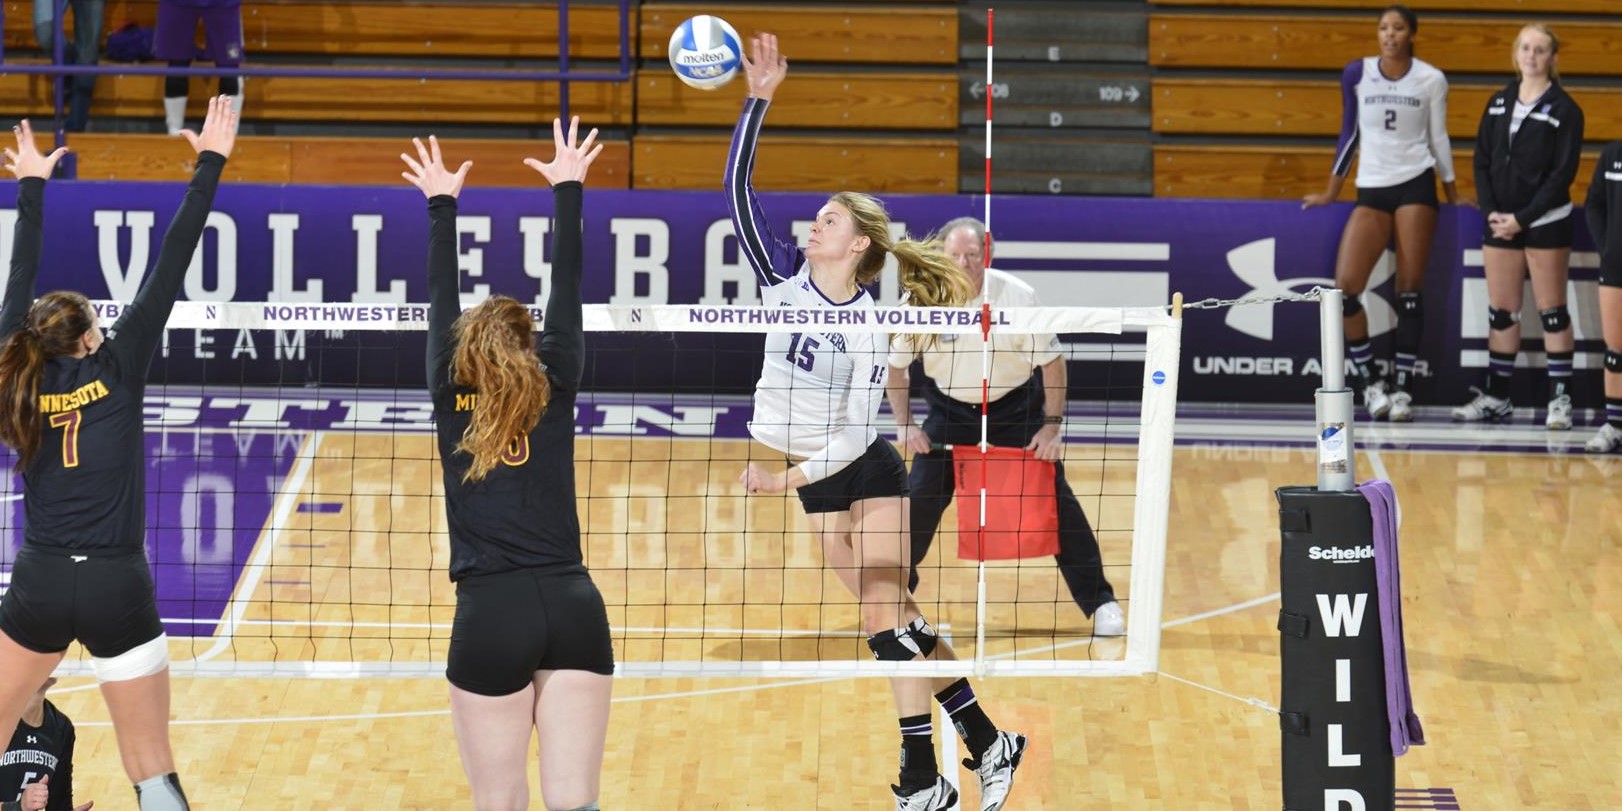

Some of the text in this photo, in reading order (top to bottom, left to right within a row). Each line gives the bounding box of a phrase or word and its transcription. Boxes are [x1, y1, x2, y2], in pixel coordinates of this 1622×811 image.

[683, 52, 725, 64] molten
[1048, 47, 1059, 61] E
[991, 83, 1009, 98] 08
[1049, 112, 1063, 127] D
[1384, 109, 1397, 131] 2
[1049, 178, 1062, 193] C
[94, 210, 907, 306] VOLLEYBA
[263, 305, 430, 321] NORTHWESTER
[688, 308, 867, 325] NORTHWESTERN
[785, 333, 821, 372] 15
[1193, 356, 1429, 377] UNDER AMOR
[39, 379, 109, 413] NNESOTA
[49, 410, 82, 468] 7
[0, 749, 59, 771] ORTHWESTER
